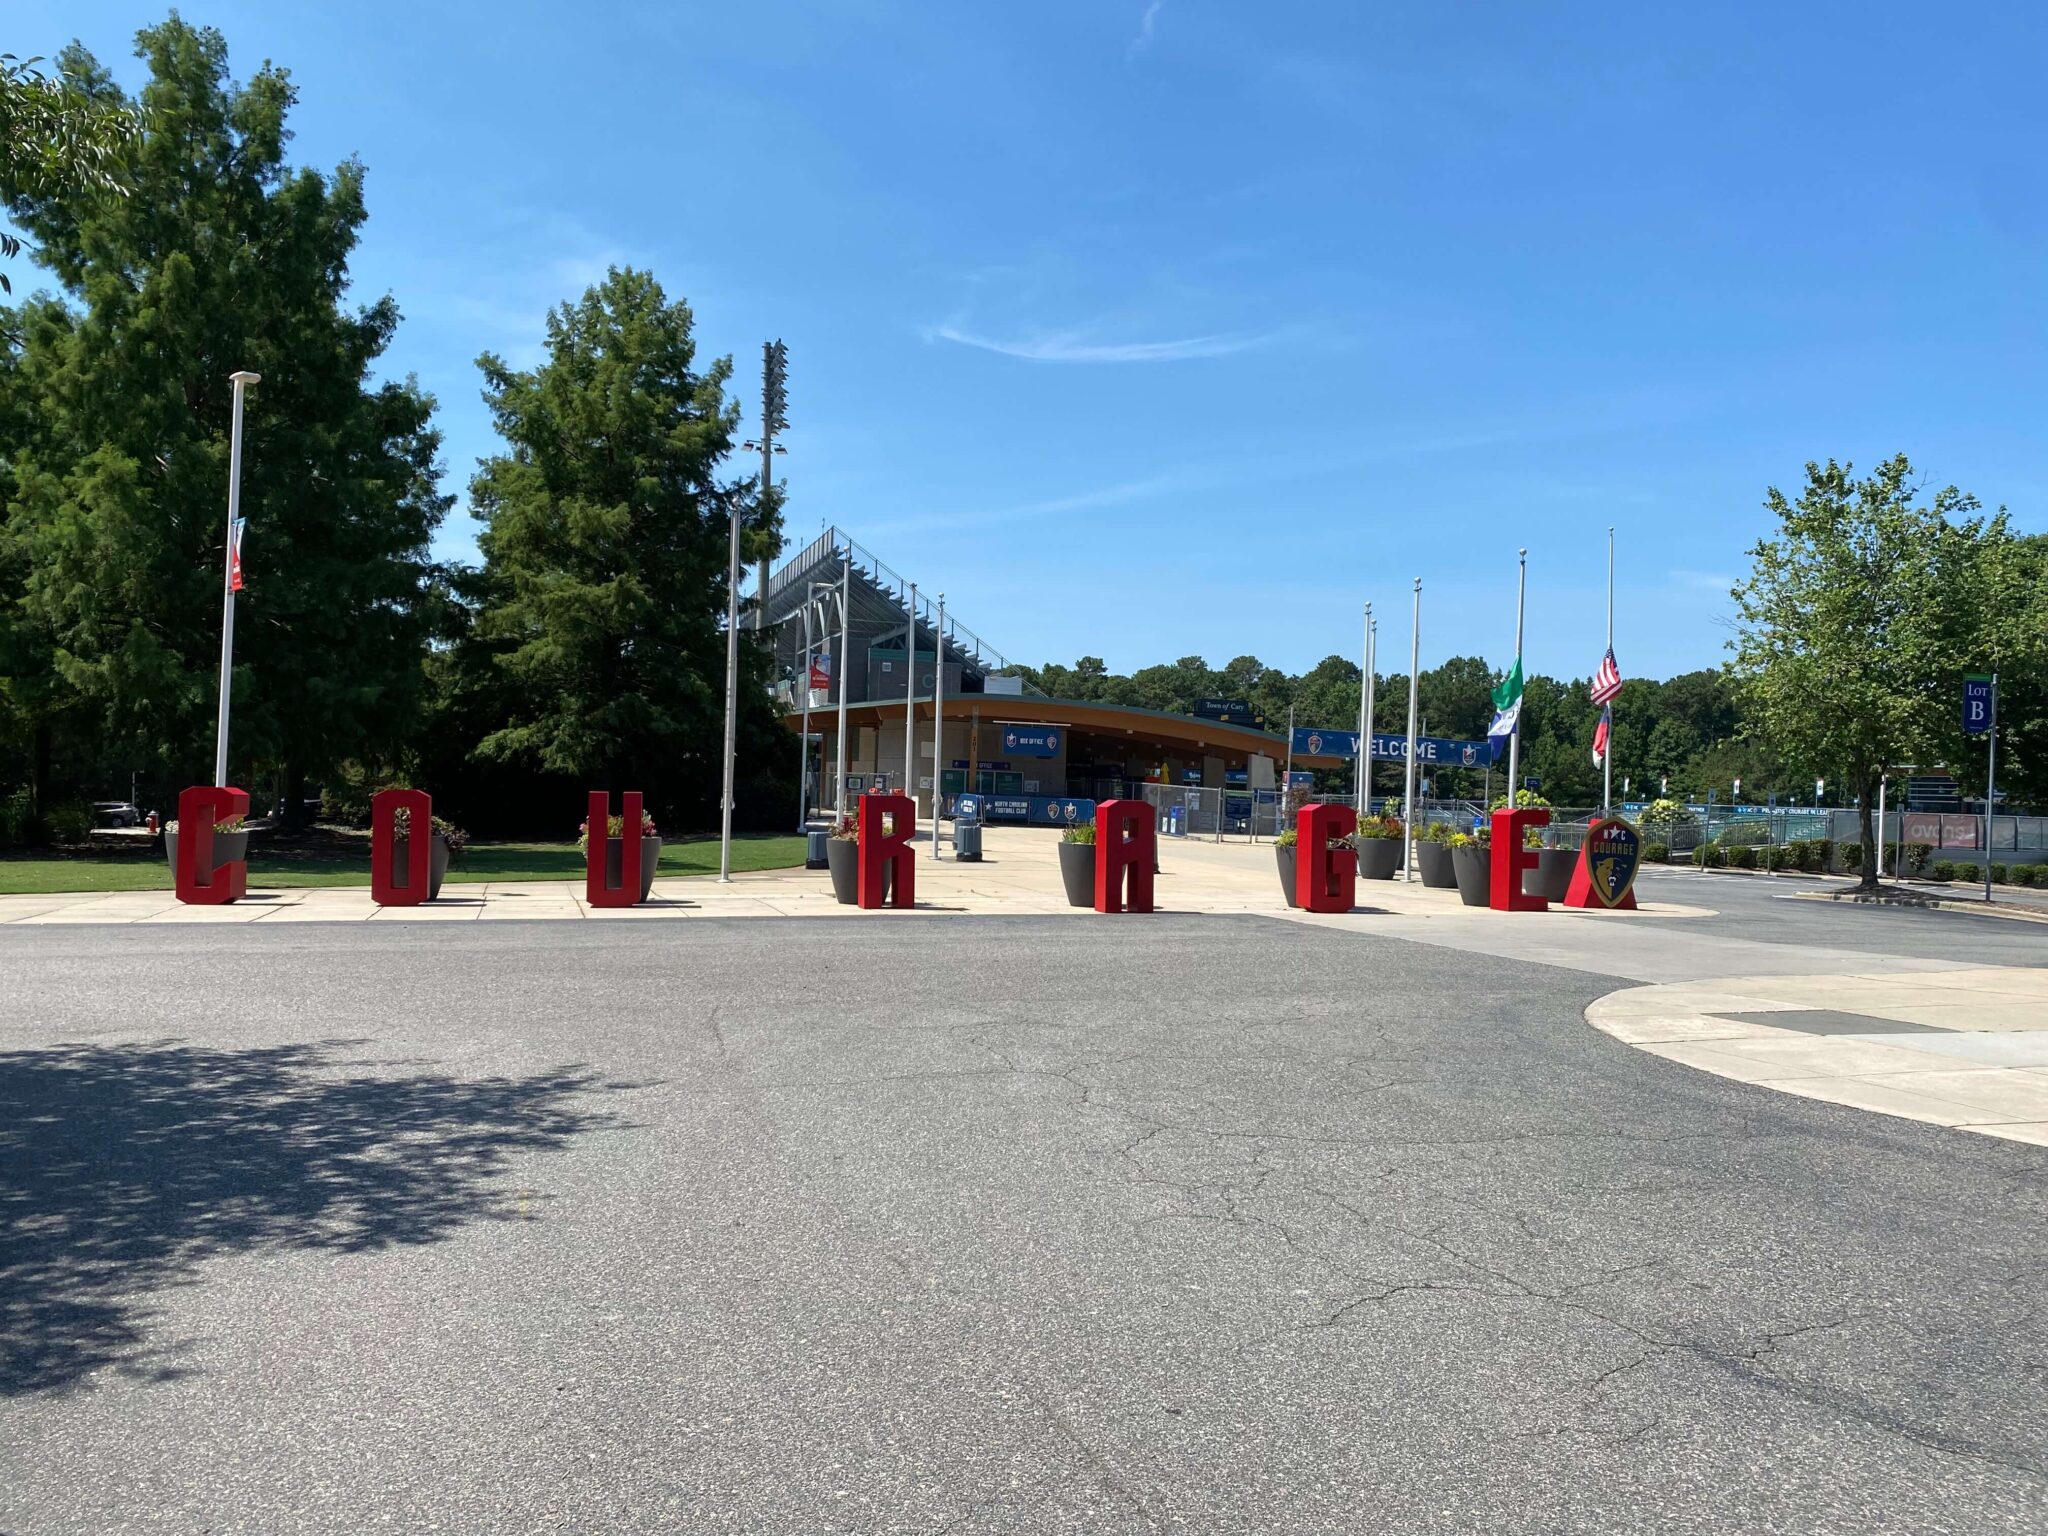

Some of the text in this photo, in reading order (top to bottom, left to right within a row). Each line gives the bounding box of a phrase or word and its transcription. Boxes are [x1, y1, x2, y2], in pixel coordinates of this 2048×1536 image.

[1231, 703, 1244, 711] Cary
[1970, 700, 1984, 720] B
[1351, 738, 1437, 759] WELCOME
[1594, 841, 1634, 856] COURAGE
